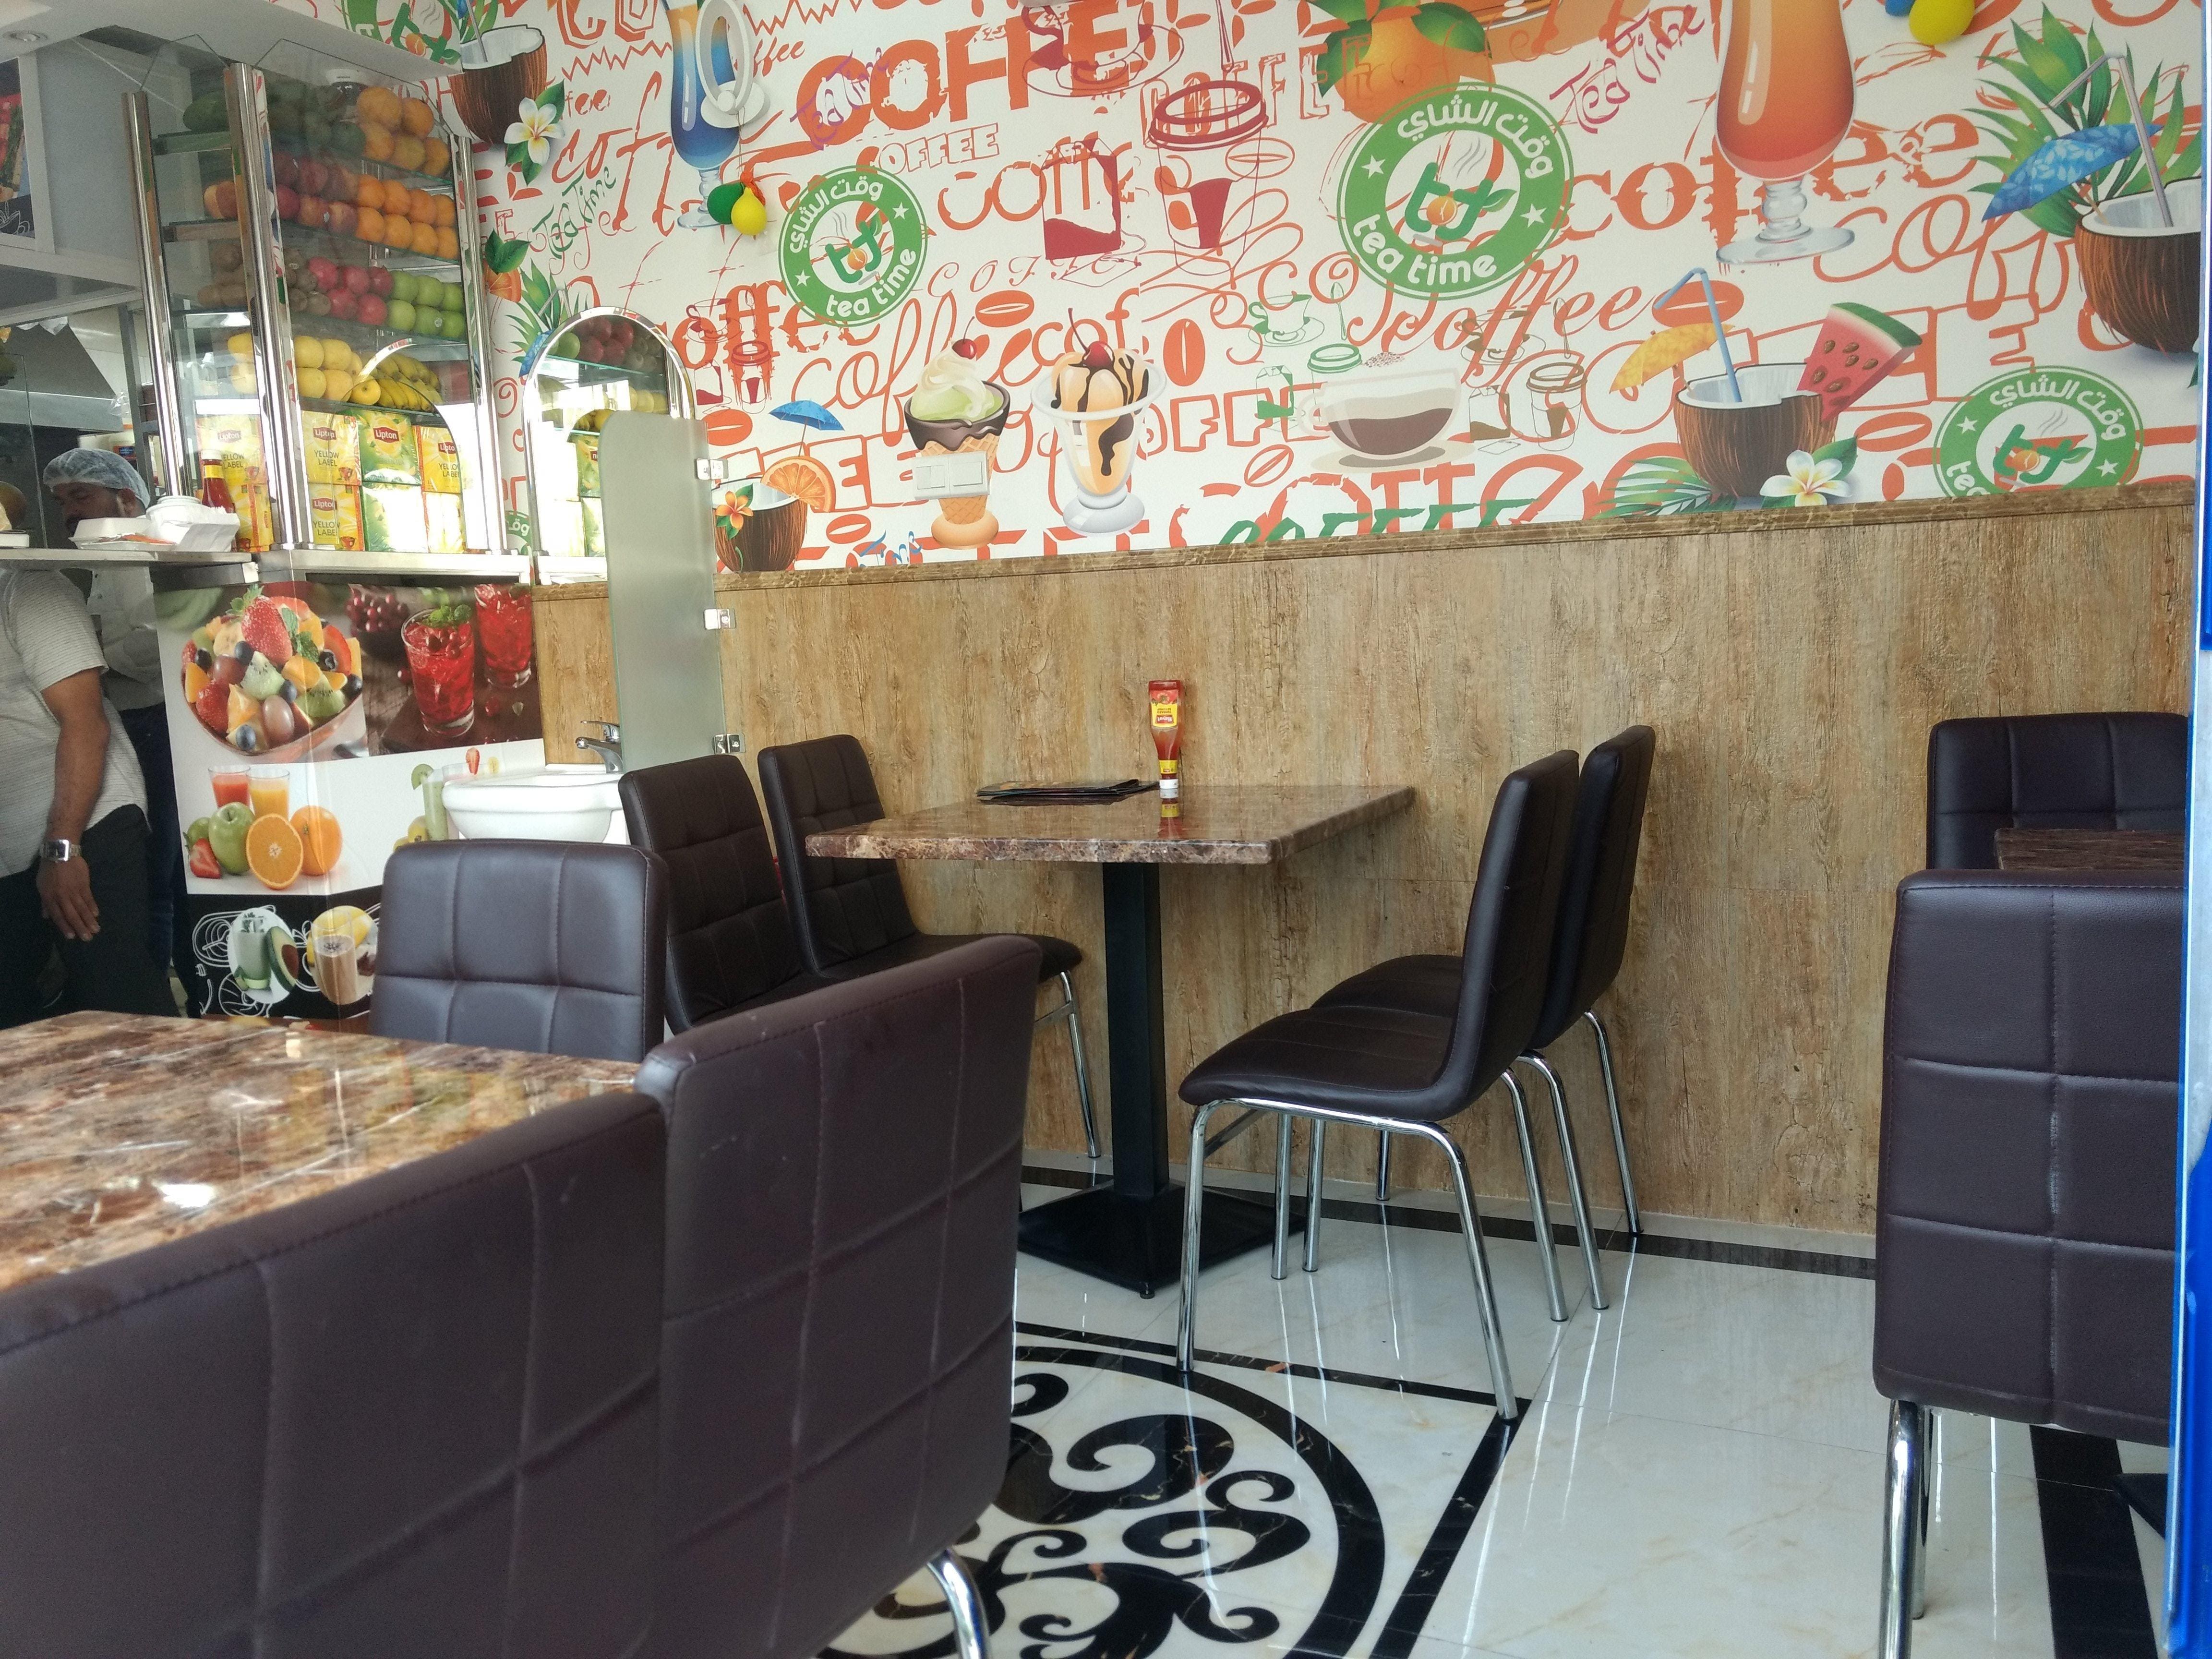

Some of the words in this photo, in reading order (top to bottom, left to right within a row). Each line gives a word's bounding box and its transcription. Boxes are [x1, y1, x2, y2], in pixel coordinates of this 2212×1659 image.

[1549, 57, 1630, 134] Tea
[532, 203, 578, 259] Tea
[562, 166, 616, 223] Time
[826, 294, 870, 317] tea
[872, 249, 916, 305] time
[1353, 214, 1404, 274] tea
[1407, 254, 1497, 286] time
[375, 429, 397, 440] Lipton
[440, 443, 455, 451] Lipto
